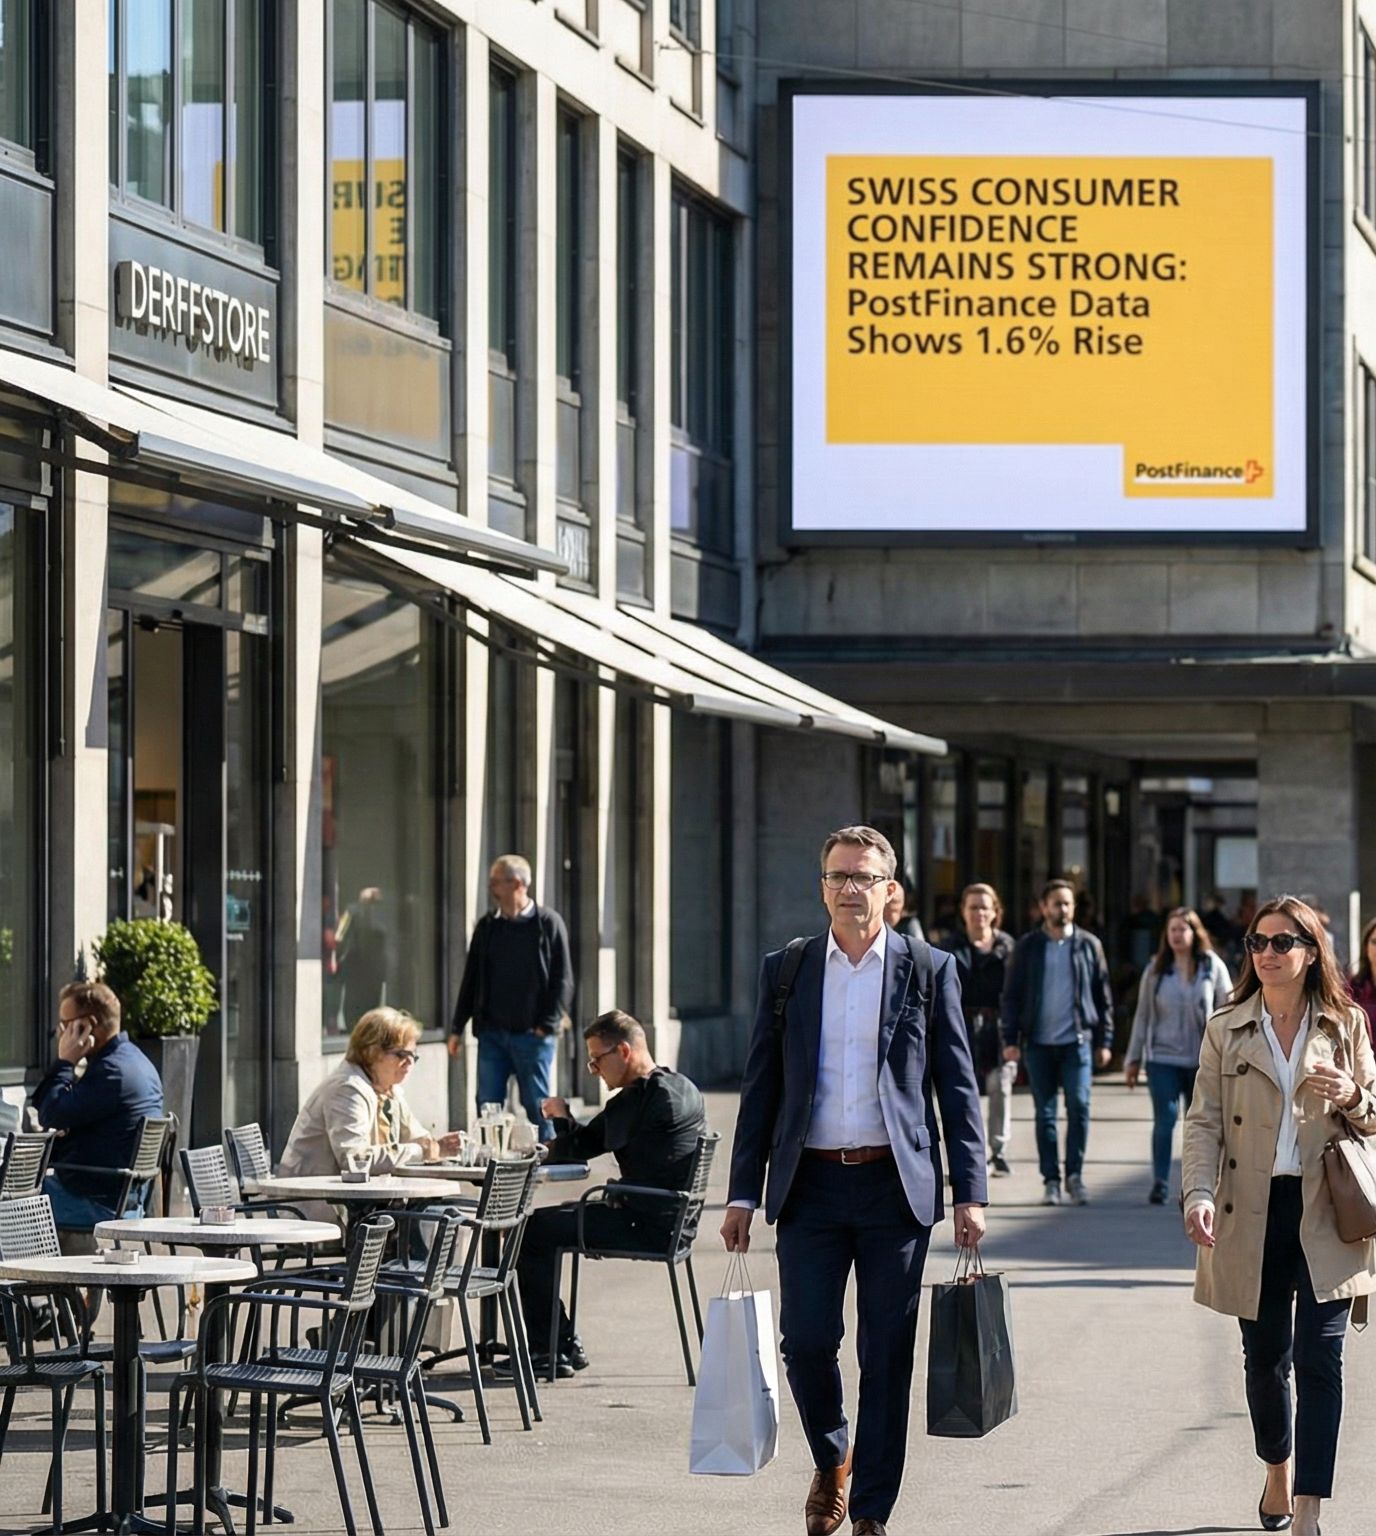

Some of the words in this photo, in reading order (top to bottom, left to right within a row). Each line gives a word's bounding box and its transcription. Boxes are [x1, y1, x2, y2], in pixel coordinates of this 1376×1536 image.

[848, 178, 958, 206] SWISS
[971, 178, 1179, 207] CONSUMER
[848, 215, 1078, 243] CONFIDENCE
[849, 252, 1014, 280] REMAINS
[1028, 252, 1187, 281] STRONG:
[131, 260, 271, 364] DERFFSTORE
[849, 288, 1056, 317] PostFinance
[1071, 290, 1150, 318] Data
[848, 325, 962, 355] Shows
[977, 326, 1060, 355] 1.6%
[1074, 326, 1143, 355] Rise
[1135, 462, 1244, 479] PostFinance
